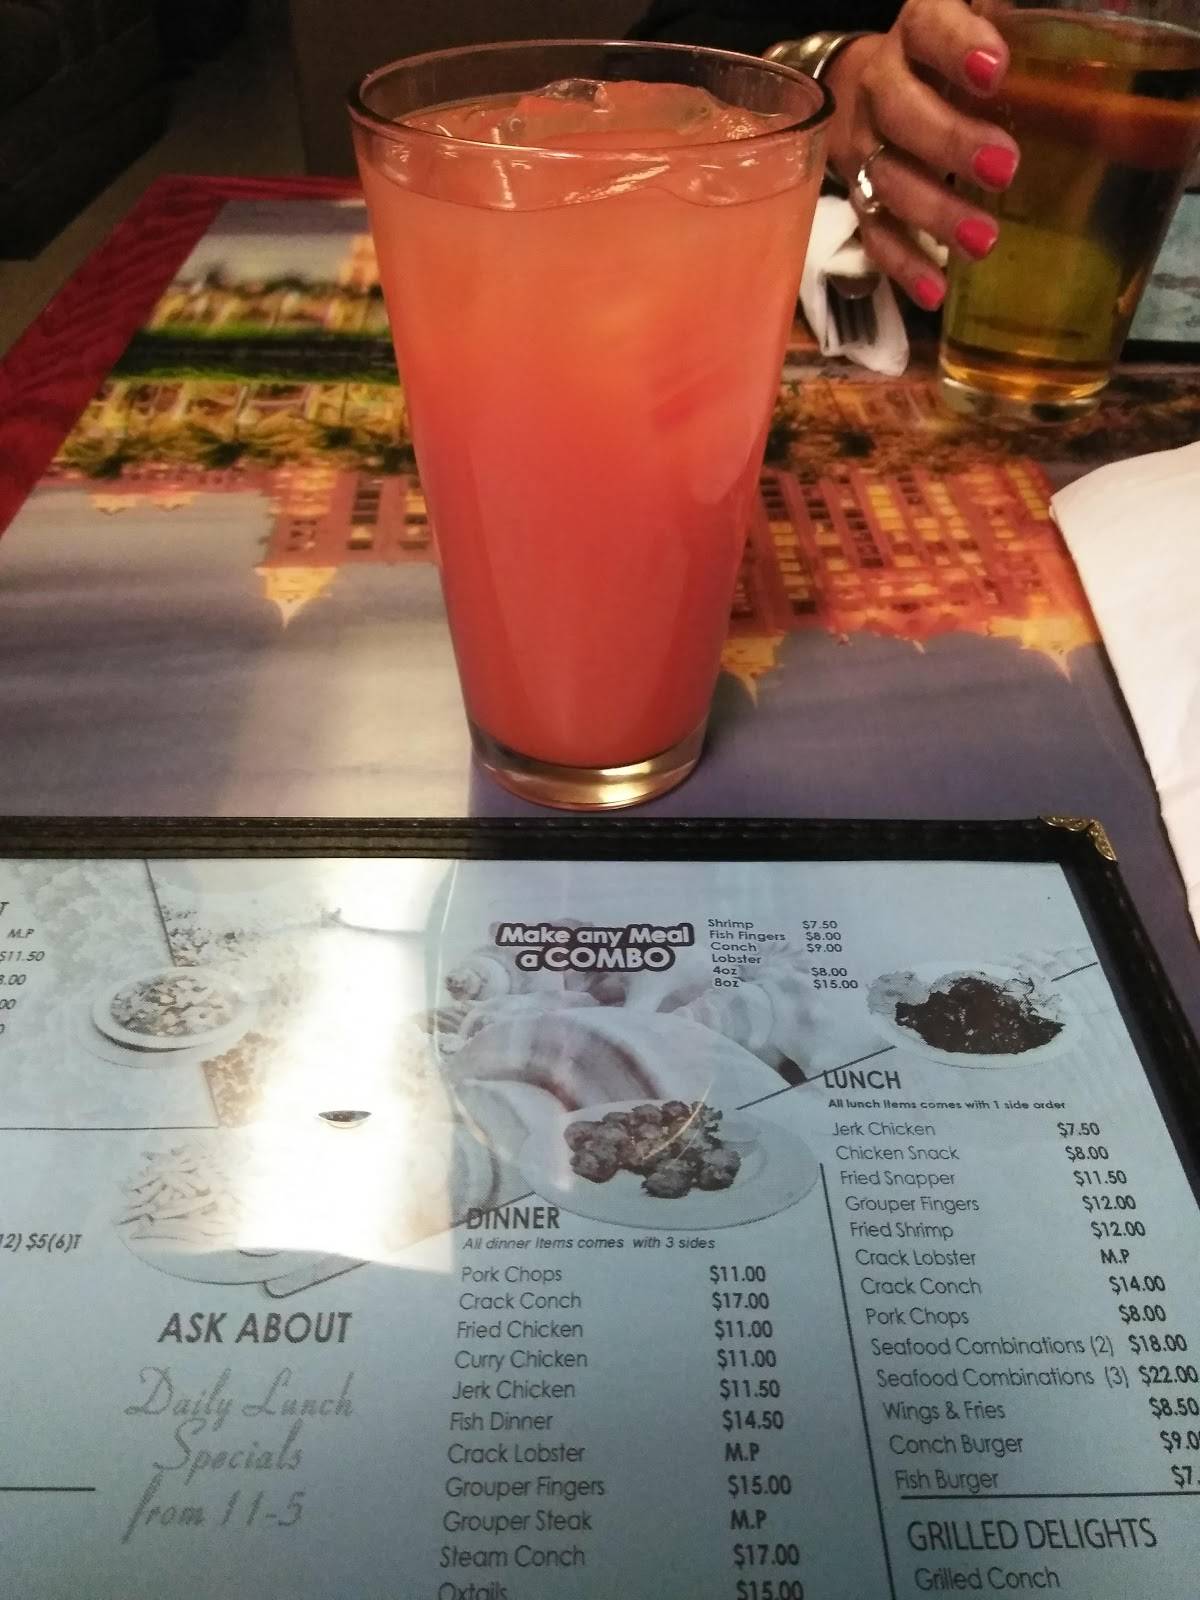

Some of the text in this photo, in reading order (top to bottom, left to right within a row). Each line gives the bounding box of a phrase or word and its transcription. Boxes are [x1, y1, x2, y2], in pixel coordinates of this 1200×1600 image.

[708, 919, 837, 931] Shrimp $7.50
[500, 926, 689, 947] Make any Meal
[709, 930, 841, 942] Fish Fingers $8.00
[521, 947, 670, 968] a COMBO
[710, 942, 842, 953] Conch $9.00
[712, 954, 761, 964] Lobster
[713, 966, 847, 977] 4oz $8.00
[714, 977, 858, 990] 8oz $15.00
[823, 1070, 902, 1089] LUNCH
[828, 1099, 843, 1108] All
[846, 1099, 880, 1109] lunch
[920, 1101, 962, 1109] comes
[965, 1100, 990, 1109] with
[993, 1100, 1000, 1108] 1
[1004, 1100, 1029, 1109] side
[1033, 1100, 1065, 1109] order
[832, 1122, 1100, 1138] Jerk Chicken $7.50
[836, 1145, 1109, 1162] Chicken Snack $8.00
[840, 1170, 1128, 1188] Fried Snapper $11.50
[845, 1195, 1136, 1215] Grouper Fingers $12.00
[467, 1207, 560, 1230] DINNER
[850, 1221, 1146, 1240] Fried Shrimp $12.00
[463, 1237, 481, 1250] All
[486, 1237, 531, 1250] dinner
[577, 1239, 624, 1249] comes
[632, 1236, 660, 1249] with
[665, 1237, 674, 1248] 3
[678, 1236, 716, 1249] sides
[856, 1249, 1129, 1266] Crack Lobster M.P
[462, 1265, 766, 1286] Pork Chops $11.00
[861, 1276, 1166, 1295] Crack Conch $14.00
[459, 1291, 770, 1311] Crack Conch $17.00
[865, 1305, 1166, 1328] Pork Chops $8.00
[157, 1312, 353, 1343] ASK ABOUT
[457, 1319, 773, 1340] Fried Chicken $11.00
[871, 1334, 1188, 1357] Seafood Combinations (2) $18.00
[454, 1349, 777, 1373] Curry Chicken $11.00
[877, 1365, 1199, 1389] Seafood Combinations (3) $22.00
[124, 1365, 355, 1432] Daily Lunch
[452, 1380, 781, 1400] Jerk Chicken $11.50
[450, 1410, 784, 1432] Fish Dinner $14.50
[883, 1397, 1200, 1424] Wings & Fries $8.50
[153, 1416, 304, 1486] Specials
[447, 1443, 760, 1464] Crack Lobster M.P
[889, 1430, 1200, 1457] Conch Burger $9.0
[445, 1475, 792, 1501] Grouper Fingers $15.00
[895, 1470, 930, 1489] Fish
[936, 1469, 999, 1493] Burger
[121, 1470, 306, 1545] from 11-5
[443, 1509, 767, 1535] Grouper Steak M.P
[907, 1518, 1157, 1551] GRILLED DELIGHTS
[438, 1544, 800, 1569] Steam Conch $17.00
[915, 1566, 1060, 1591] Grilled Conch
[438, 1580, 804, 1600] Oxtails $15.00
